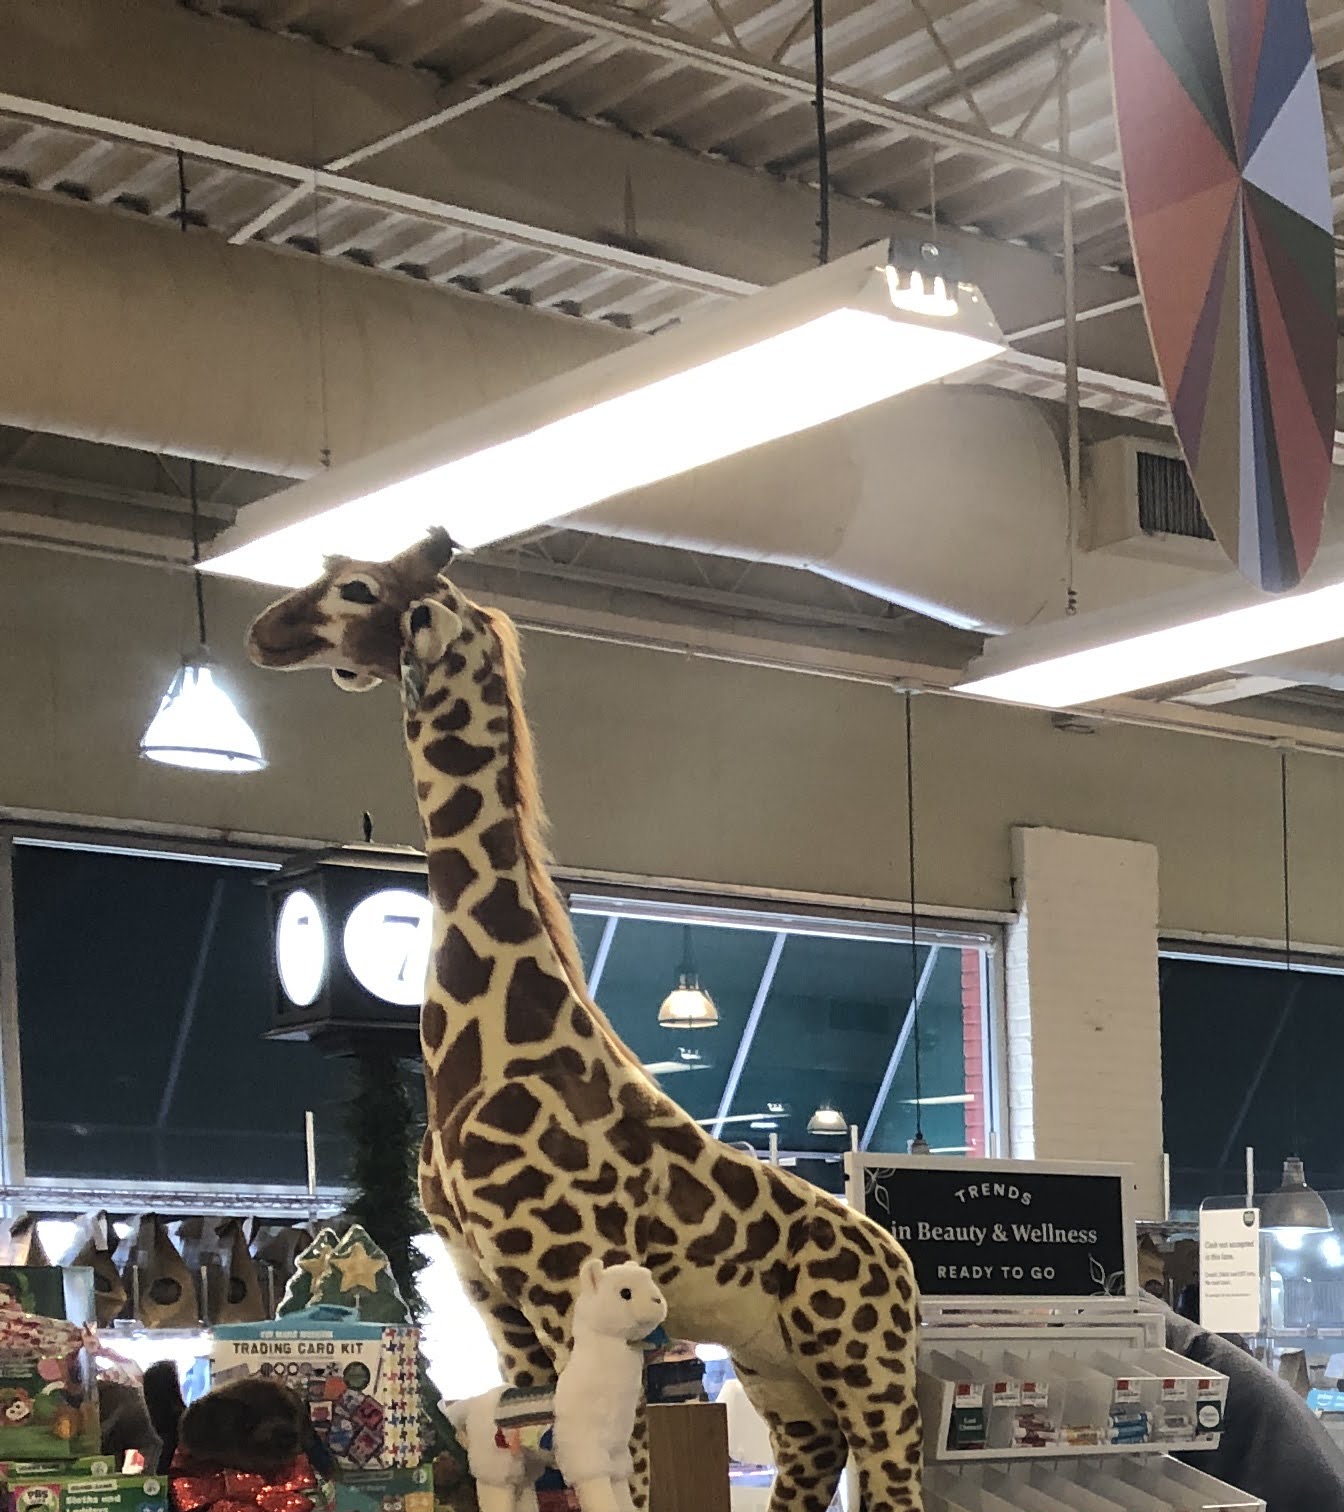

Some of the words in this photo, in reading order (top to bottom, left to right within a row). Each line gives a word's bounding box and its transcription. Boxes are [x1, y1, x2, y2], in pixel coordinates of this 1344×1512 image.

[955, 1183, 1032, 1206] TRENDS
[891, 1221, 912, 1241] in
[917, 1221, 988, 1247] Beauty
[992, 1223, 1008, 1243] &
[1010, 1224, 1098, 1245] Wellness
[937, 1265, 993, 1281] READY
[1001, 1266, 1023, 1280] TO
[1030, 1266, 1056, 1281] GO
[233, 1342, 292, 1355] TRADING
[298, 1343, 335, 1355] CARD
[341, 1343, 363, 1354] KIT
